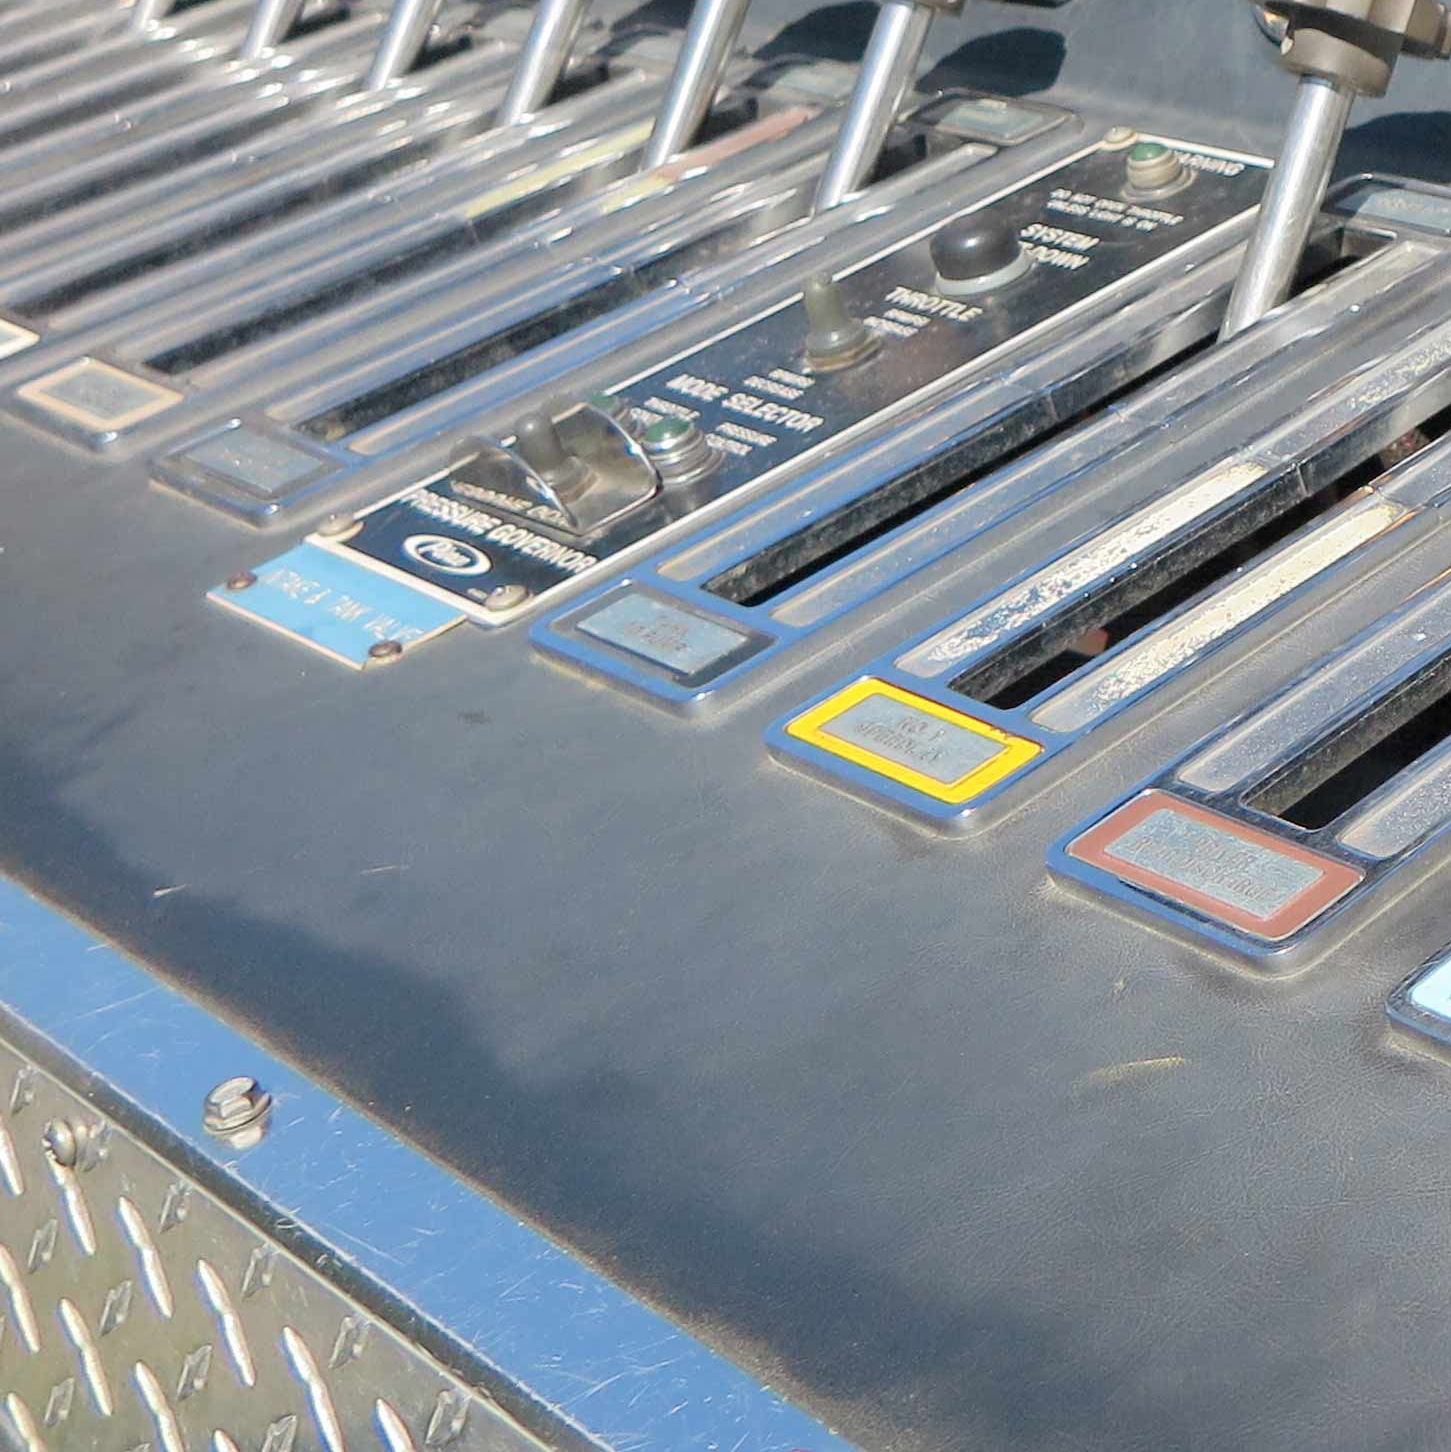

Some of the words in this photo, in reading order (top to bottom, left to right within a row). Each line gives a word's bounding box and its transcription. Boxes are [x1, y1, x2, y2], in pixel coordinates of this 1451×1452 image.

[1019, 223, 1100, 253] SYSTEM
[884, 285, 984, 323] THROTTLE
[664, 372, 730, 402] MODE
[721, 392, 826, 434] SELECTOR
[402, 488, 501, 537] PRESSURE
[486, 521, 600, 574] GOVERNOR
